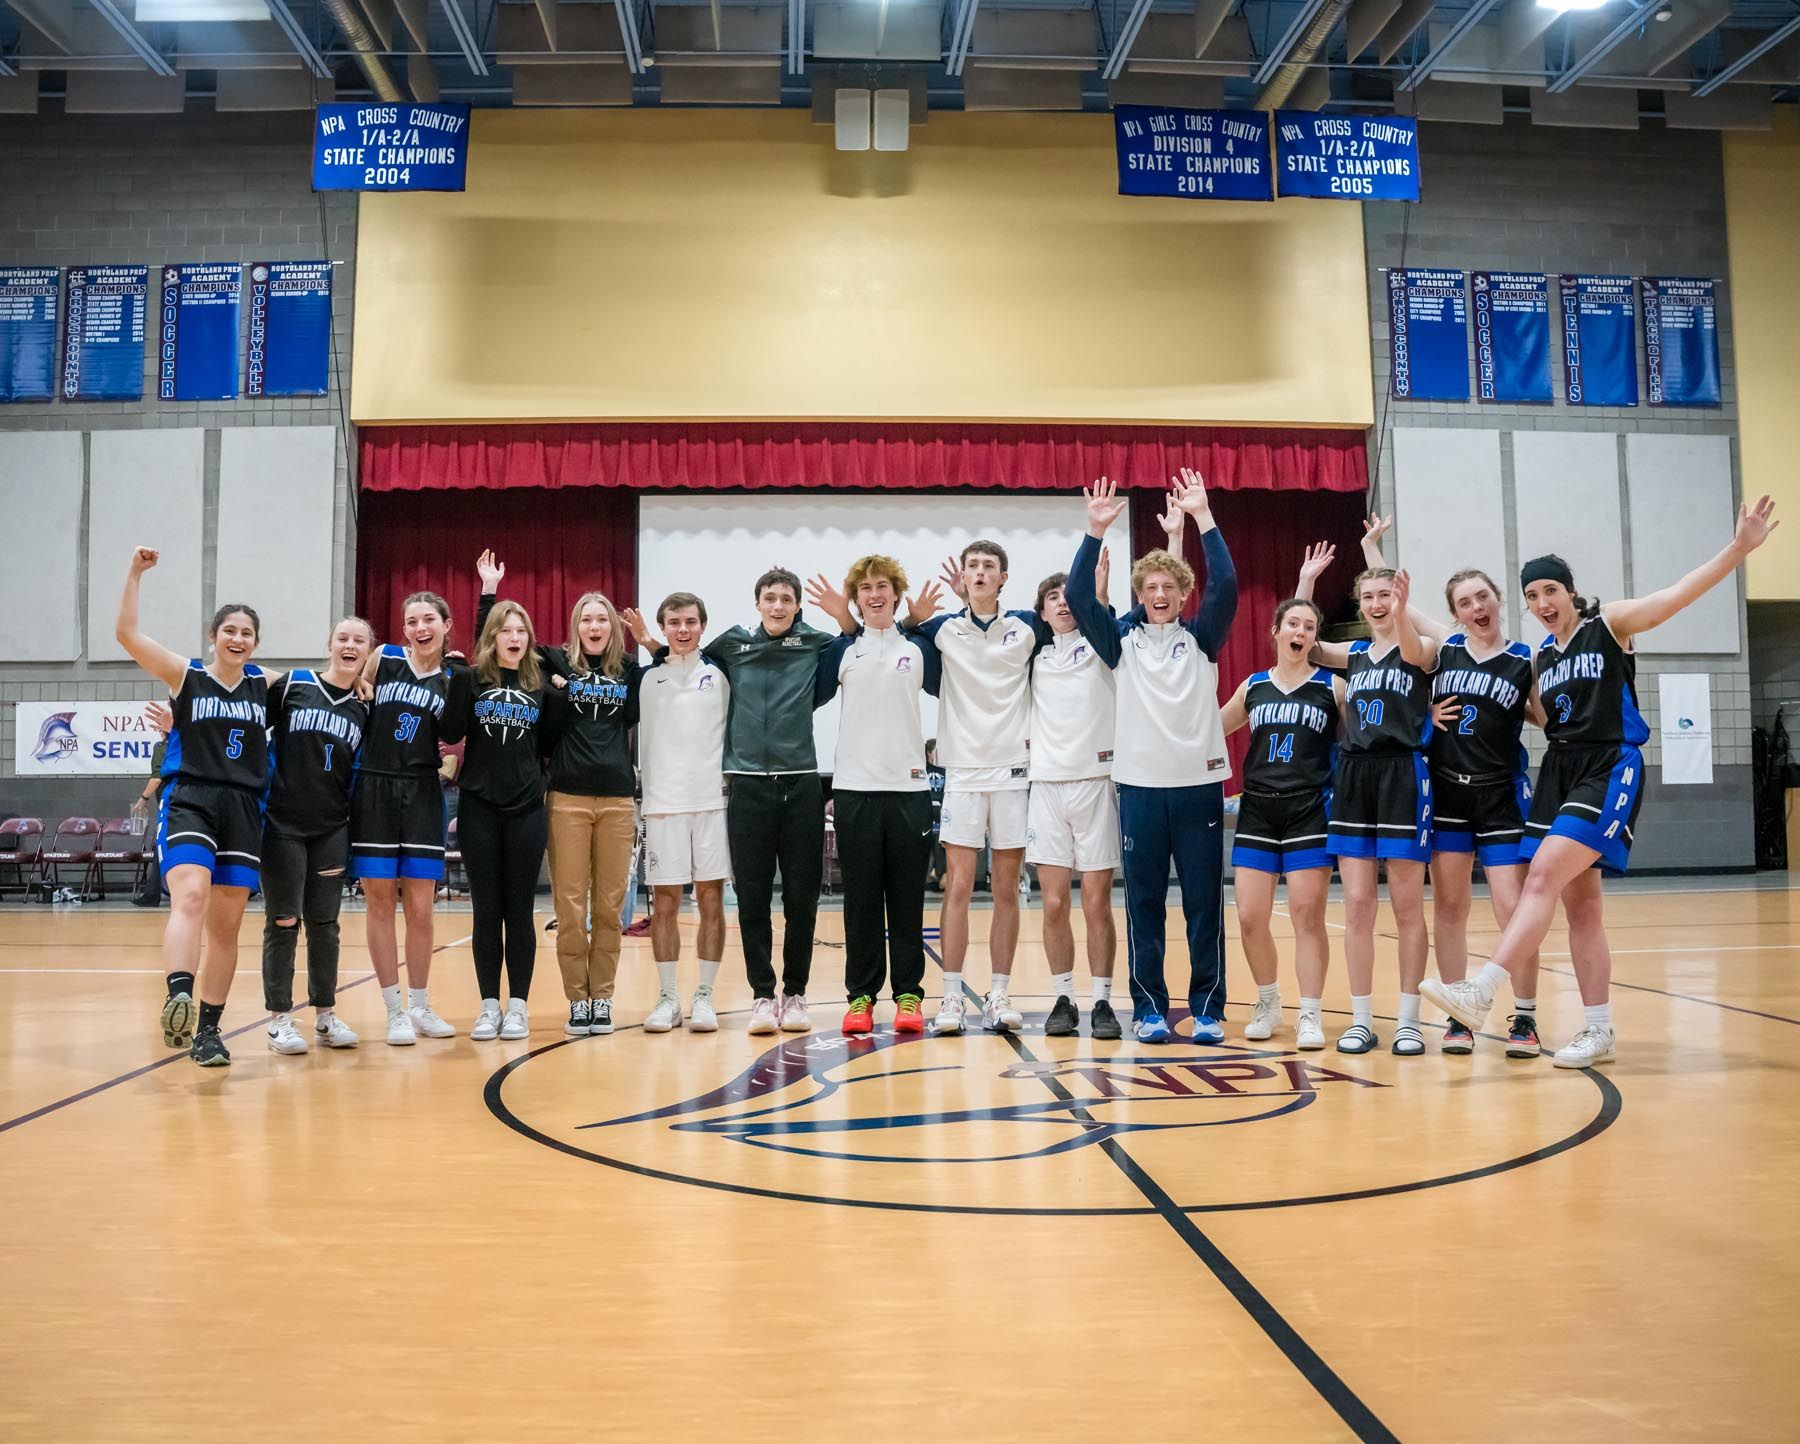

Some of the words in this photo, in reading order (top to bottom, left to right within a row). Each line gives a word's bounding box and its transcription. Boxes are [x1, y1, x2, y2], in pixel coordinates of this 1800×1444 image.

[321, 116, 346, 136] NPA
[358, 108, 397, 126] CROSS
[409, 109, 464, 133] COUNTRY
[1123, 120, 1144, 138] NPA
[1149, 115, 1176, 132] GIRLS
[1184, 115, 1212, 132] CROSS
[1222, 120, 1262, 142] COUNTRY
[1281, 124, 1304, 142] NPA
[1314, 120, 1351, 136] CROSS
[1363, 122, 1414, 146] COUNTRY
[362, 129, 420, 145] 1/A-2/A
[1154, 136, 1212, 154] DIVISION
[1226, 139, 1234, 154] 4
[1320, 140, 1376, 157] 1/A-2/A
[324, 148, 365, 165] STATE
[378, 148, 455, 164] CHAMPIONS
[1128, 154, 1172, 171] STATE
[1186, 156, 1260, 174] CHAMPIONS
[1288, 155, 1328, 172] STATE
[1337, 159, 1410, 176] CHAMPIONS
[364, 168, 410, 184] 2004
[1178, 176, 1214, 192] 2014
[1331, 177, 1372, 194] 2005
[0, 286, 58, 296] CHAMPIONS
[87, 284, 146, 294] CHAMPIONS
[181, 282, 241, 293] CHAMPIONS
[270, 280, 330, 290] CHAMPIONS
[1408, 287, 1464, 298] CHAMPIONS
[1491, 290, 1547, 301] CHAMPIONS
[1579, 293, 1633, 304] CHAMPIONS
[1659, 296, 1714, 306] CHAMPIONS
[161, 288, 177, 398] SOCCER
[249, 284, 266, 395] VOLLEYBALL
[1476, 293, 1494, 399] SOCCER
[1564, 296, 1581, 402] TENNIS
[65, 335, 80, 398] COUNTRY
[1574, 653, 1604, 678] PREP
[568, 681, 628, 699] SPARTAN
[1386, 668, 1413, 697] PREP
[1490, 677, 1520, 710] PREP
[192, 696, 252, 723] NORTHLAND
[474, 700, 540, 724] SPARTAN
[568, 694, 624, 706] BASKETBALL
[1556, 694, 1572, 723] 3
[103, 715, 147, 732] NPA
[289, 708, 348, 738] NORTHLAND
[394, 712, 421, 743] 31
[480, 716, 531, 730] BASKETBALL
[1302, 704, 1328, 734] PREP
[1458, 704, 1477, 735] 2
[60, 738, 78, 750] NPA
[93, 741, 152, 758] SENI
[226, 729, 245, 760] 5
[1268, 733, 1294, 762] 14
[324, 744, 334, 771] 1
[1420, 779, 1430, 847] NPA
[1604, 766, 1634, 840] NPA
[1070, 1060, 1394, 1098] NPA
